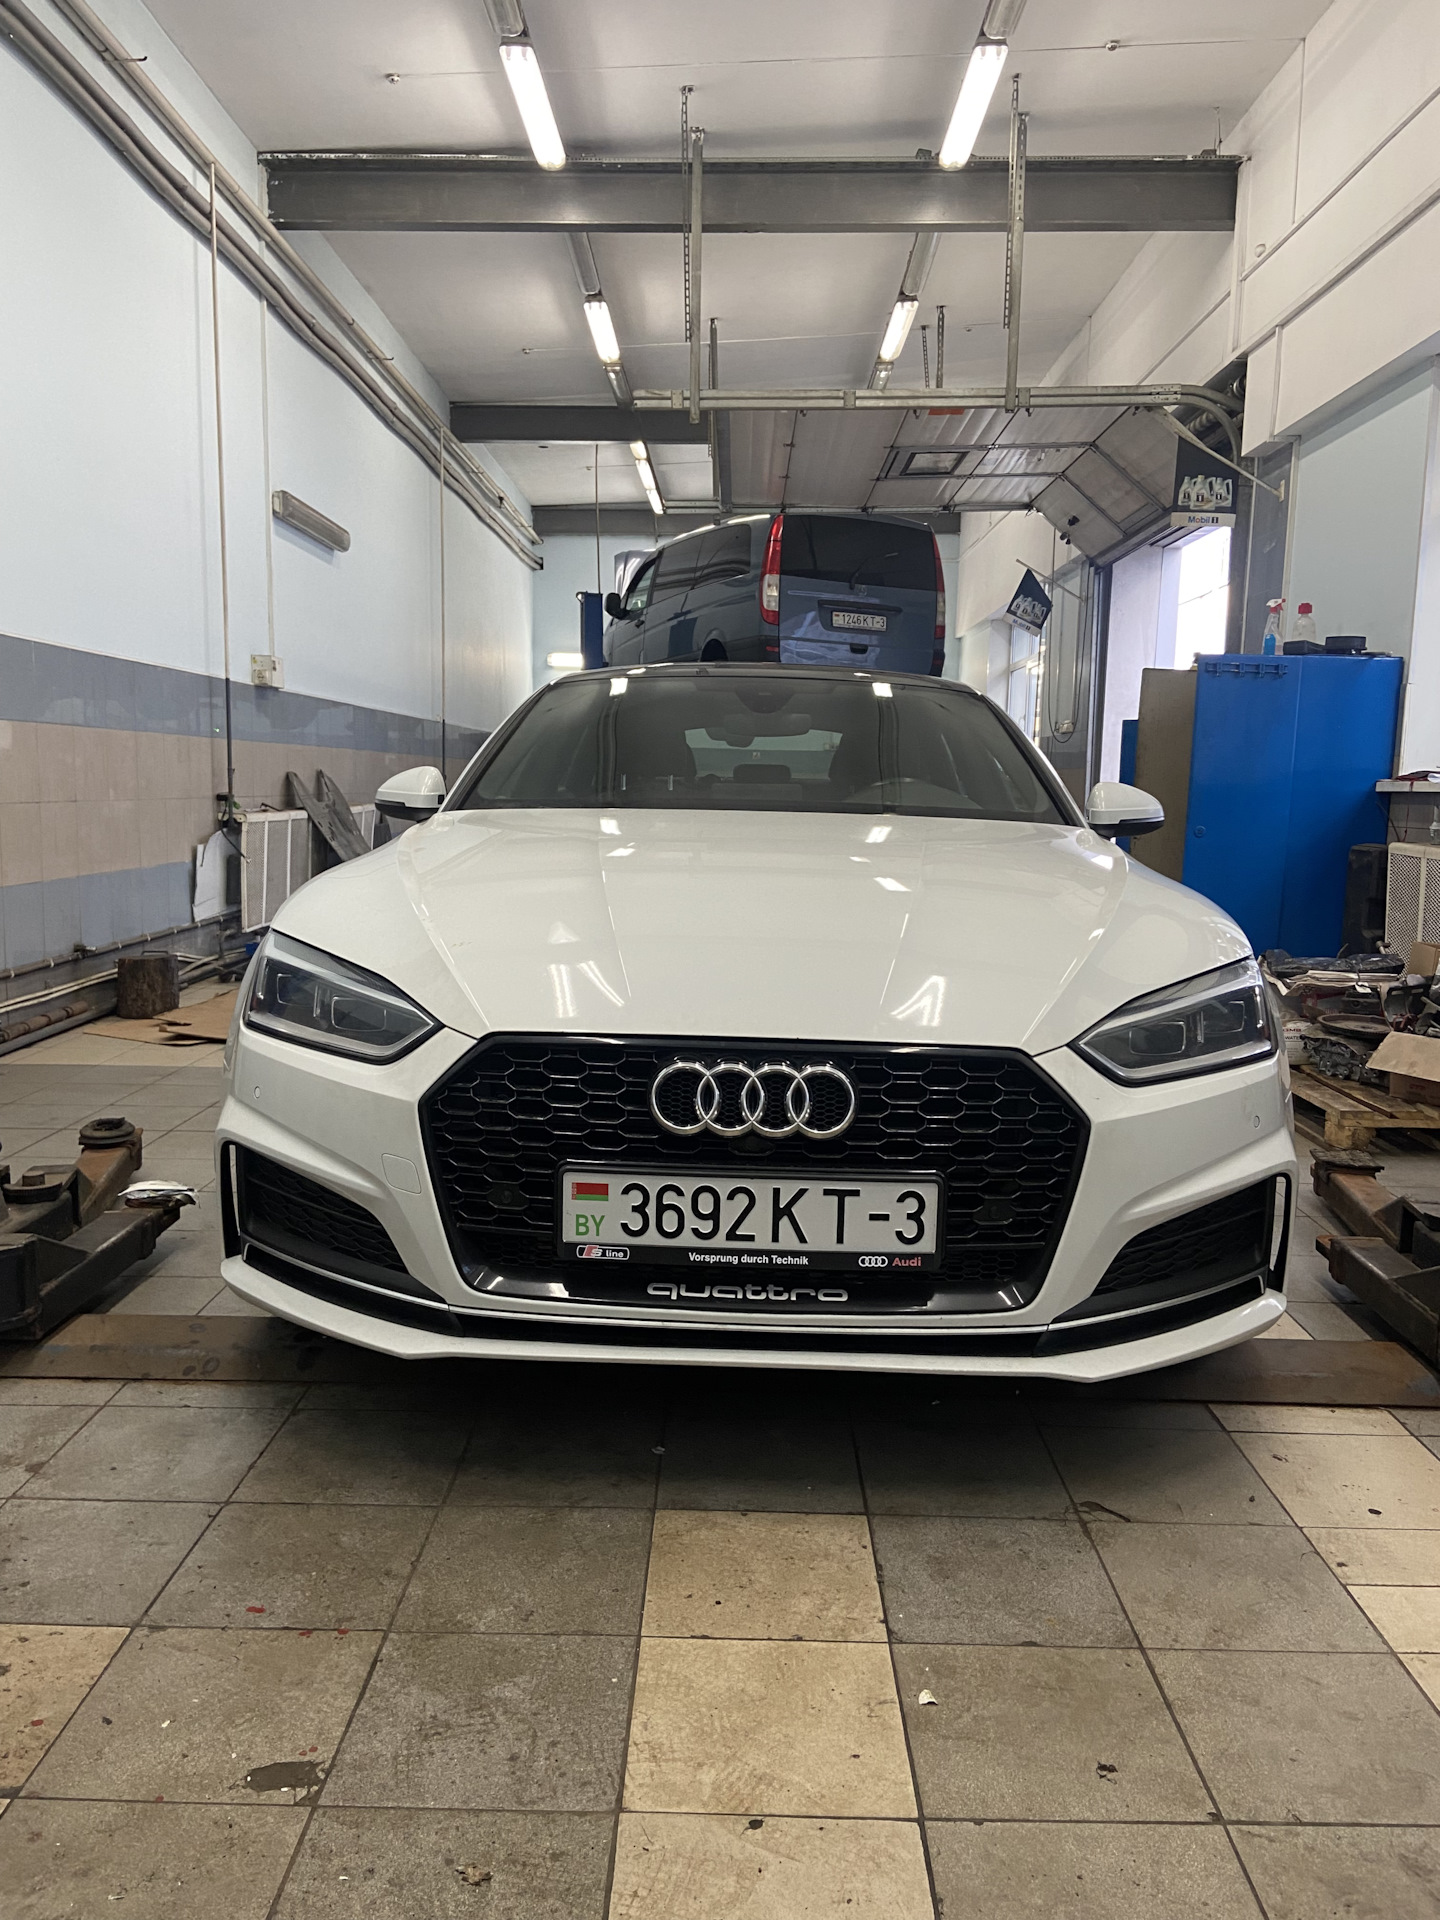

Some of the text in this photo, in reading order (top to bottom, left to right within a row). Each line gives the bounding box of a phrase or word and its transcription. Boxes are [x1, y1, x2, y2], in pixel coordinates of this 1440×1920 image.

[1188, 516, 1210, 524] Mobil
[575, 1213, 606, 1237] BY
[605, 1249, 624, 1258] line
[688, 1252, 808, 1265] Vorsprung durch Technik
[892, 1256, 922, 1267] Audi
[647, 1282, 848, 1302] quattro
